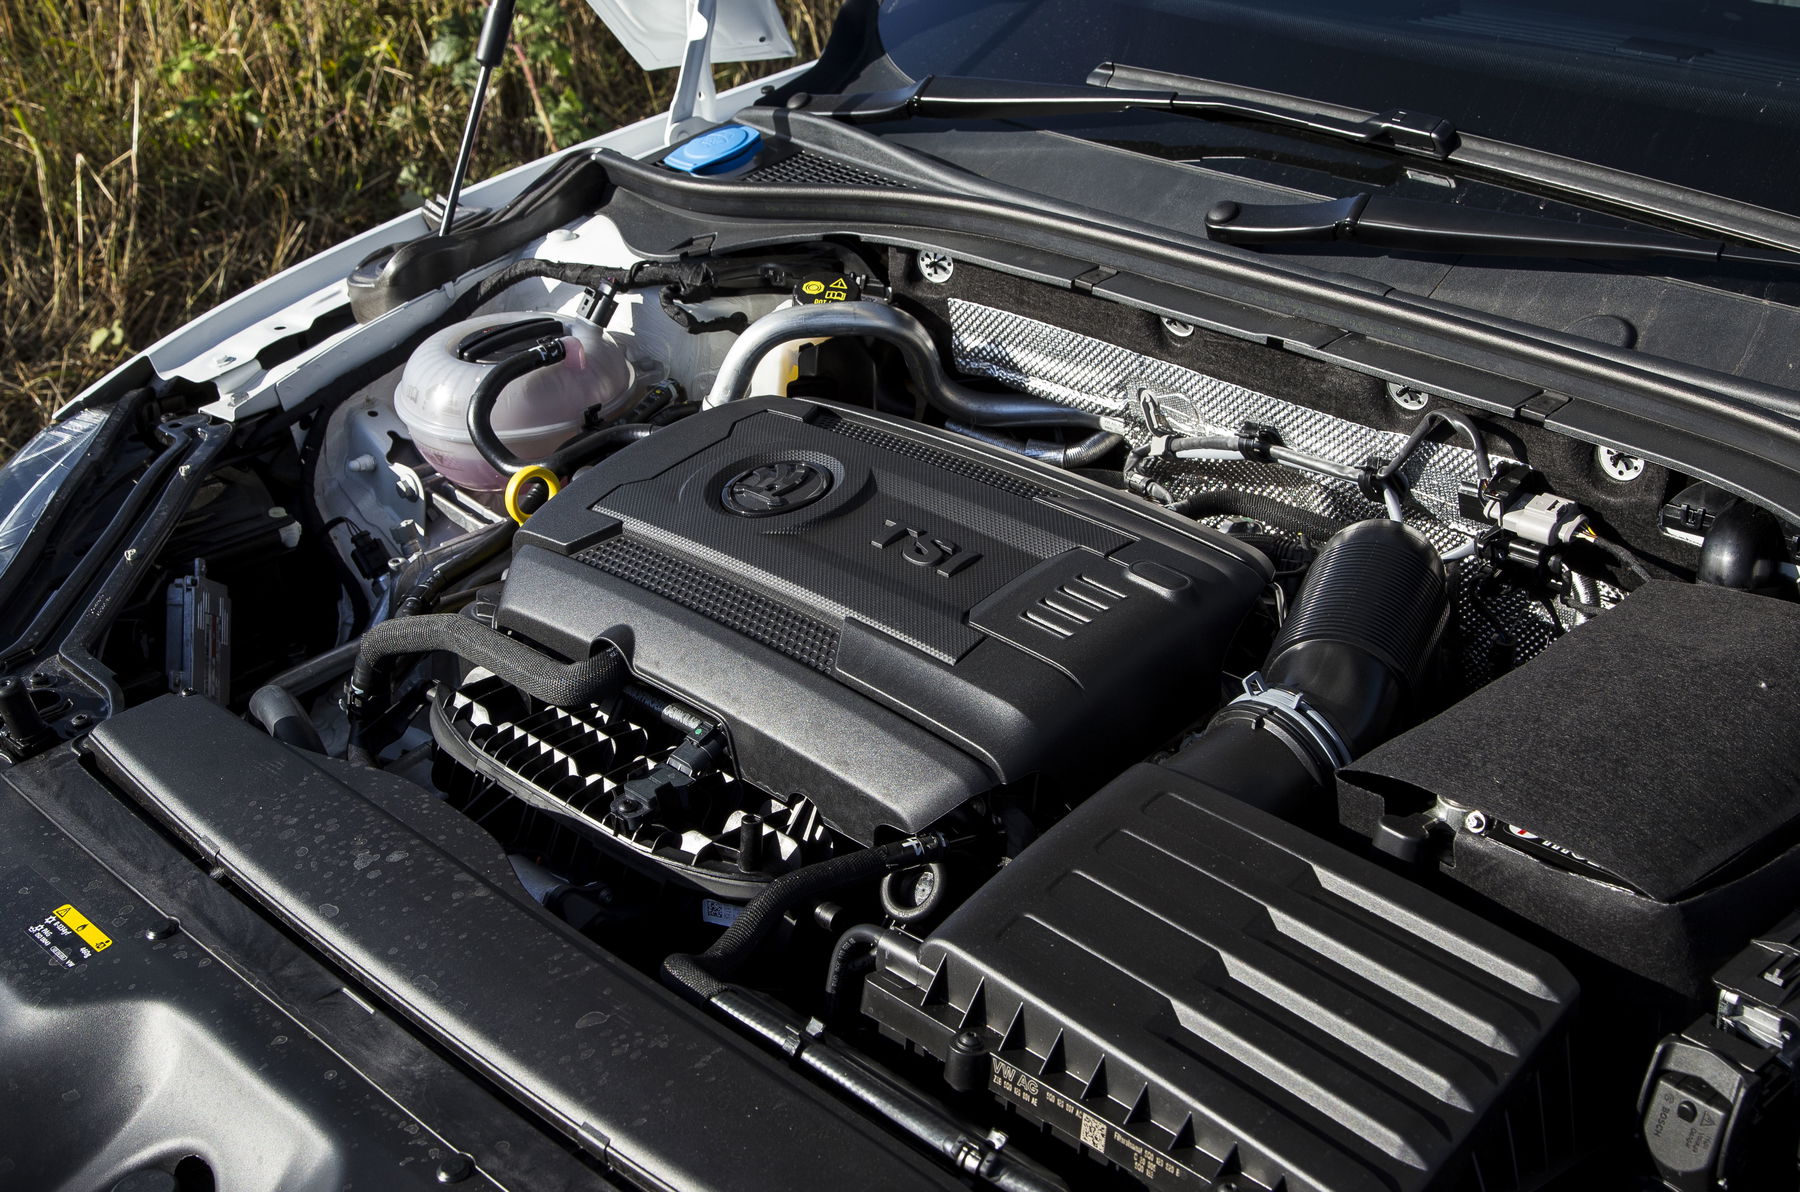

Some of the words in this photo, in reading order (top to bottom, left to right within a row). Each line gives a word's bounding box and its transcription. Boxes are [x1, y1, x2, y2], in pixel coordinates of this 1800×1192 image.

[869, 519, 984, 578] TSI
[992, 1057, 1017, 1082] VW
[1016, 1074, 1039, 1096] AG
[1653, 1106, 1671, 1138] BOSCH
